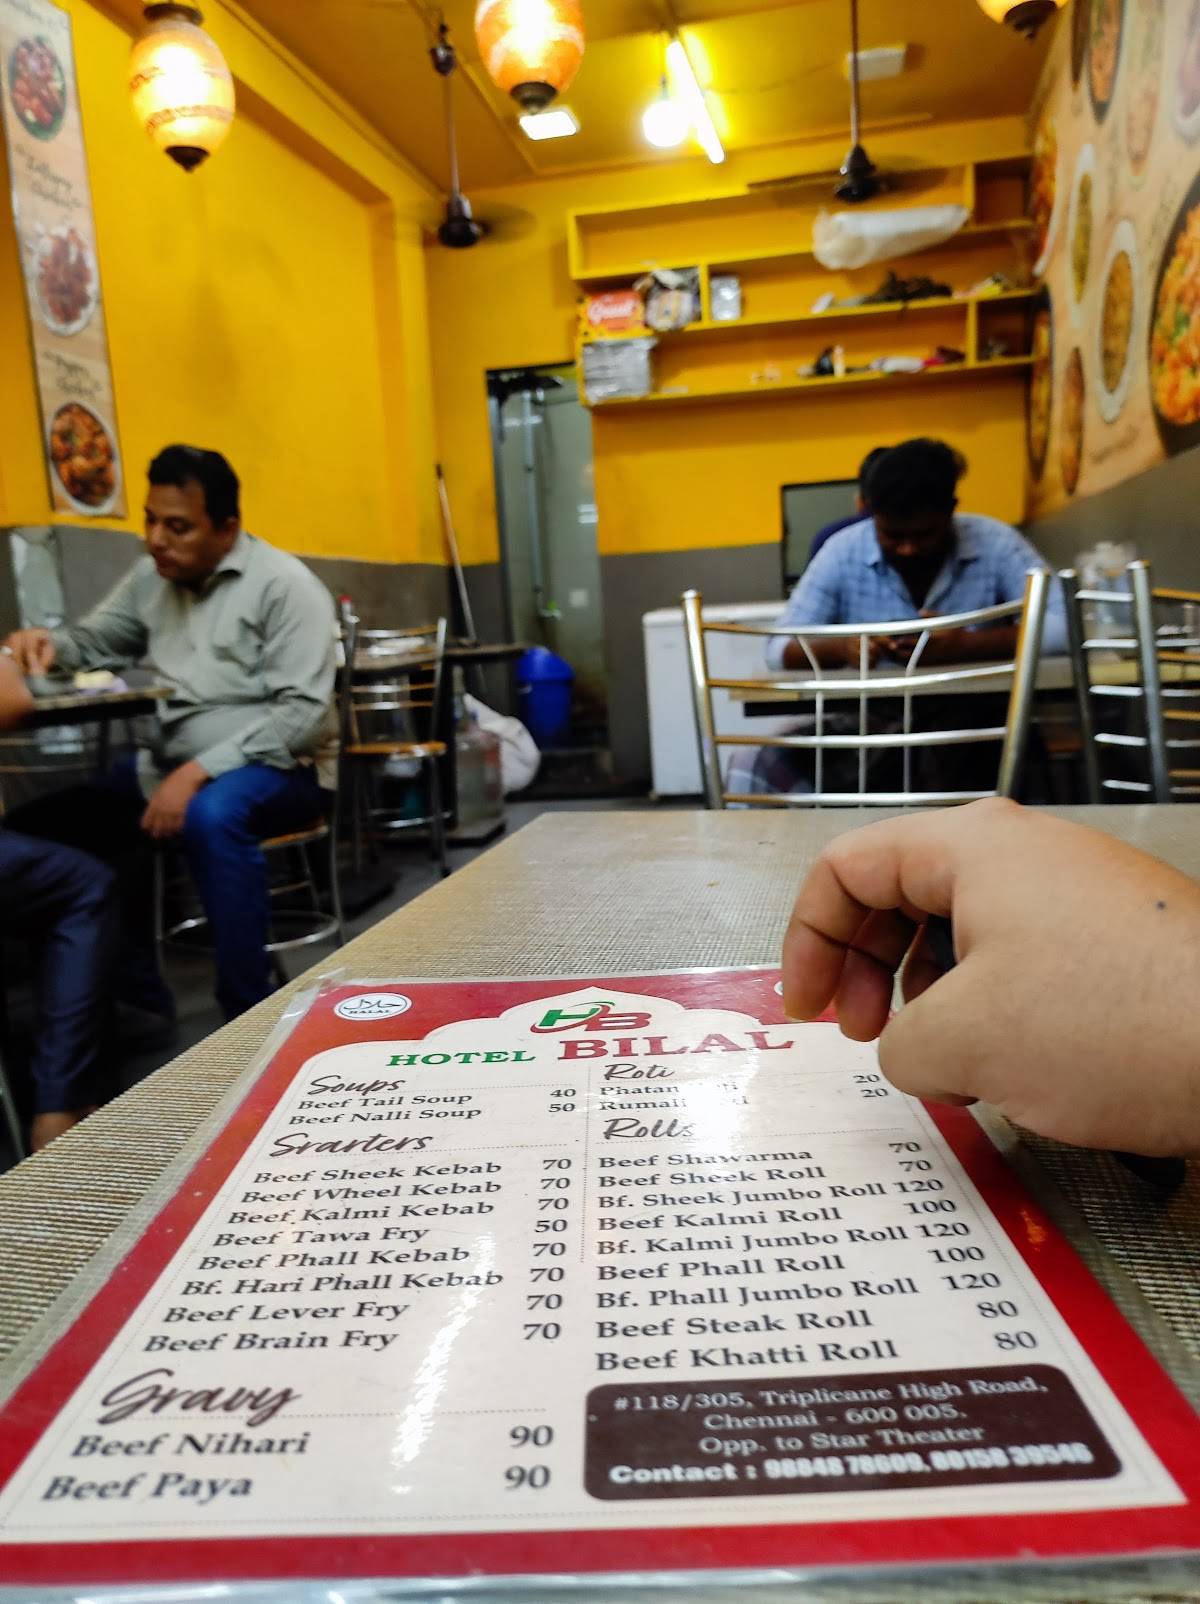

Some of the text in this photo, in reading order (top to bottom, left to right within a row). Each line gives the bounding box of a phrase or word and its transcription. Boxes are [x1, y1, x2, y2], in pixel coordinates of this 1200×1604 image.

[386, 1031, 794, 1067] HOTEL BILAL
[307, 1074, 406, 1096] Soups
[604, 1063, 675, 1081] Roti
[853, 1074, 880, 1084] 20
[297, 1088, 577, 1110] Beef Tail Soup 40
[600, 1097, 687, 1111] Rumali
[862, 1087, 889, 1098] 20
[288, 1103, 576, 1125] Beef Nalli Soup 50
[604, 1116, 695, 1140] Rolls
[598, 1142, 921, 1169] Beef Shawarma 70
[253, 1158, 572, 1185] Beef Sheek Kebab 70
[598, 1160, 933, 1188] Beef Sheek Roll 70
[240, 1177, 571, 1203] Beef Wheel Kebab 70
[598, 1178, 945, 1209] Bf. Sheek Jumbo Roll 120
[227, 1198, 569, 1225] Beef Kalmi Kebab 70
[598, 1199, 957, 1231] Beef Kalmi Roll 100
[212, 1219, 568, 1247] Beef Tawa Fry 50
[597, 1222, 971, 1255] Bf. Kalmi Jumbo Roll 120
[197, 1242, 567, 1271] Beef Phall Kebab 70
[597, 1246, 983, 1281] Beef Phall Roll 100
[181, 1267, 565, 1296] Bf. Hari Phall Kebab 70
[596, 1271, 1003, 1309] Bf. Phall Jumbo Roll 120
[163, 1293, 564, 1323] Beef Lever Fry 70
[595, 1300, 1020, 1340] Beef Steak Roll 80
[143, 1322, 562, 1352] Beef Brain Fry 70
[595, 1330, 1039, 1372] Beef Khatti Roll 80
[97, 1368, 303, 1427] Gravy
[759, 1386, 892, 1408] Triplicane
[898, 1381, 964, 1401] High
[703, 1409, 820, 1430] Chennai
[845, 1406, 898, 1424] 600
[903, 1403, 968, 1421] 005.
[70, 1425, 555, 1458] Beef Nihari 90
[698, 1427, 986, 1457] Opp. to Star Theater
[41, 1464, 551, 1505] Beef Paya 90
[608, 1462, 738, 1484] Contact
